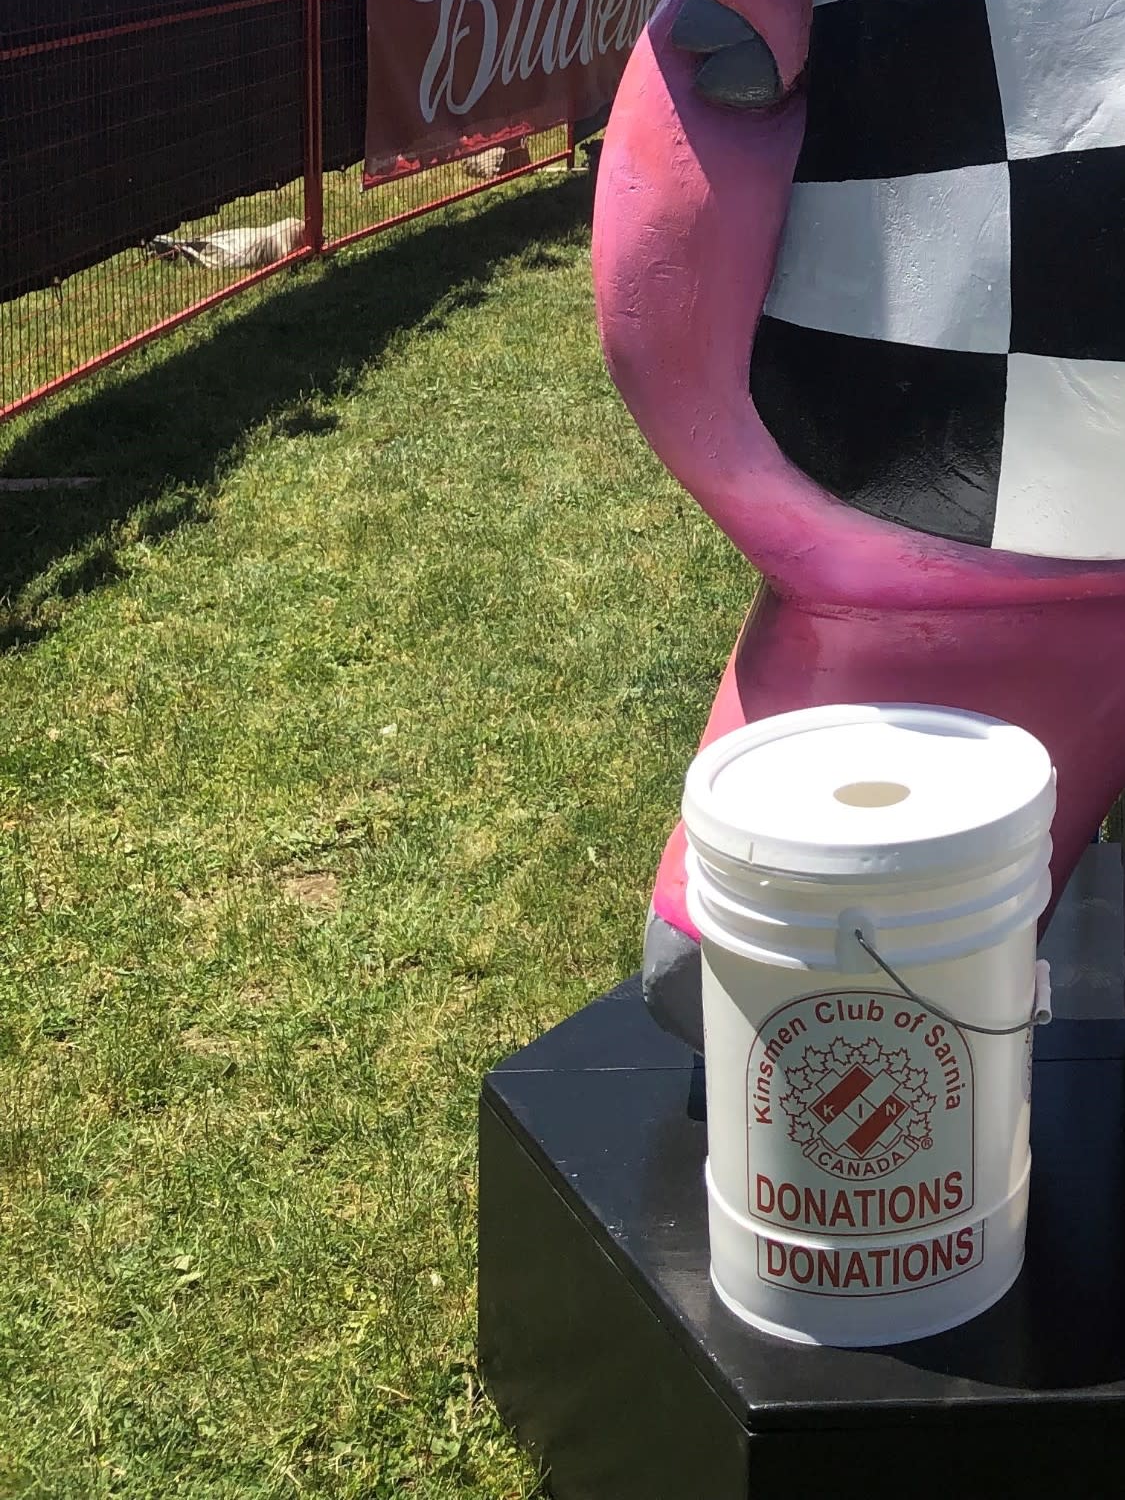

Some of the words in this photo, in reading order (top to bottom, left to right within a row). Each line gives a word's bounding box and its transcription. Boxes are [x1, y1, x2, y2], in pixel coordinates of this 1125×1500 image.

[753, 1016, 807, 1125] Kinsmen
[815, 999, 884, 1024] Club
[894, 1011, 925, 1034] of
[924, 1023, 966, 1110] Sarnia
[818, 1151, 906, 1177] CANADA
[756, 1170, 963, 1228] DONATIONS
[764, 1226, 974, 1288] DONATIONS
